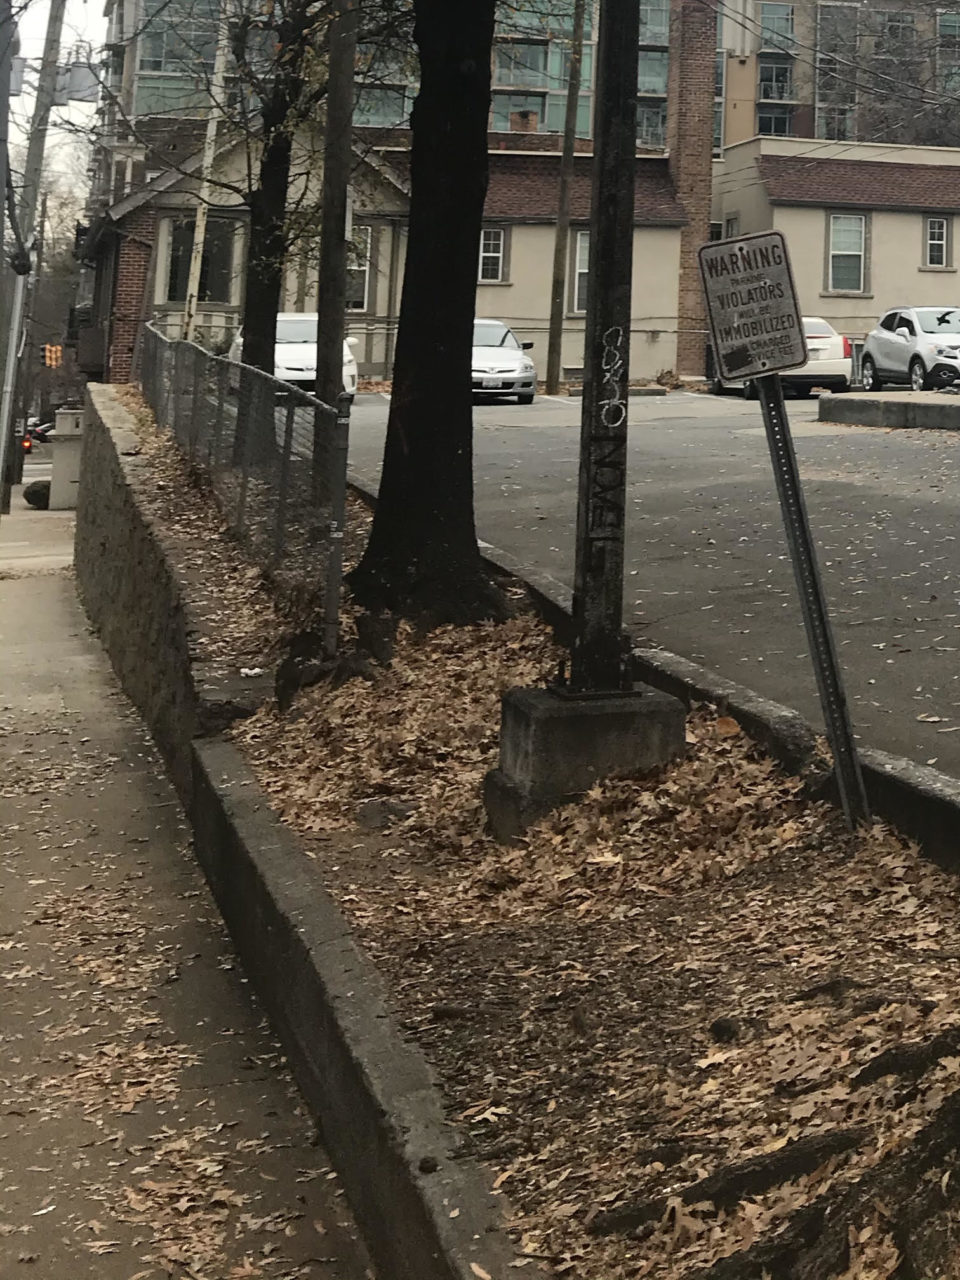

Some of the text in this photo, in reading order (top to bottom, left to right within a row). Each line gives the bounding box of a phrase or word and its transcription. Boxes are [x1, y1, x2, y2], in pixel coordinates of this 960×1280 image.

[705, 244, 783, 279] WARNING
[717, 282, 785, 310] VIOLATORS
[759, 305, 771, 315] BE
[718, 314, 796, 343] IMMOBILIZED
